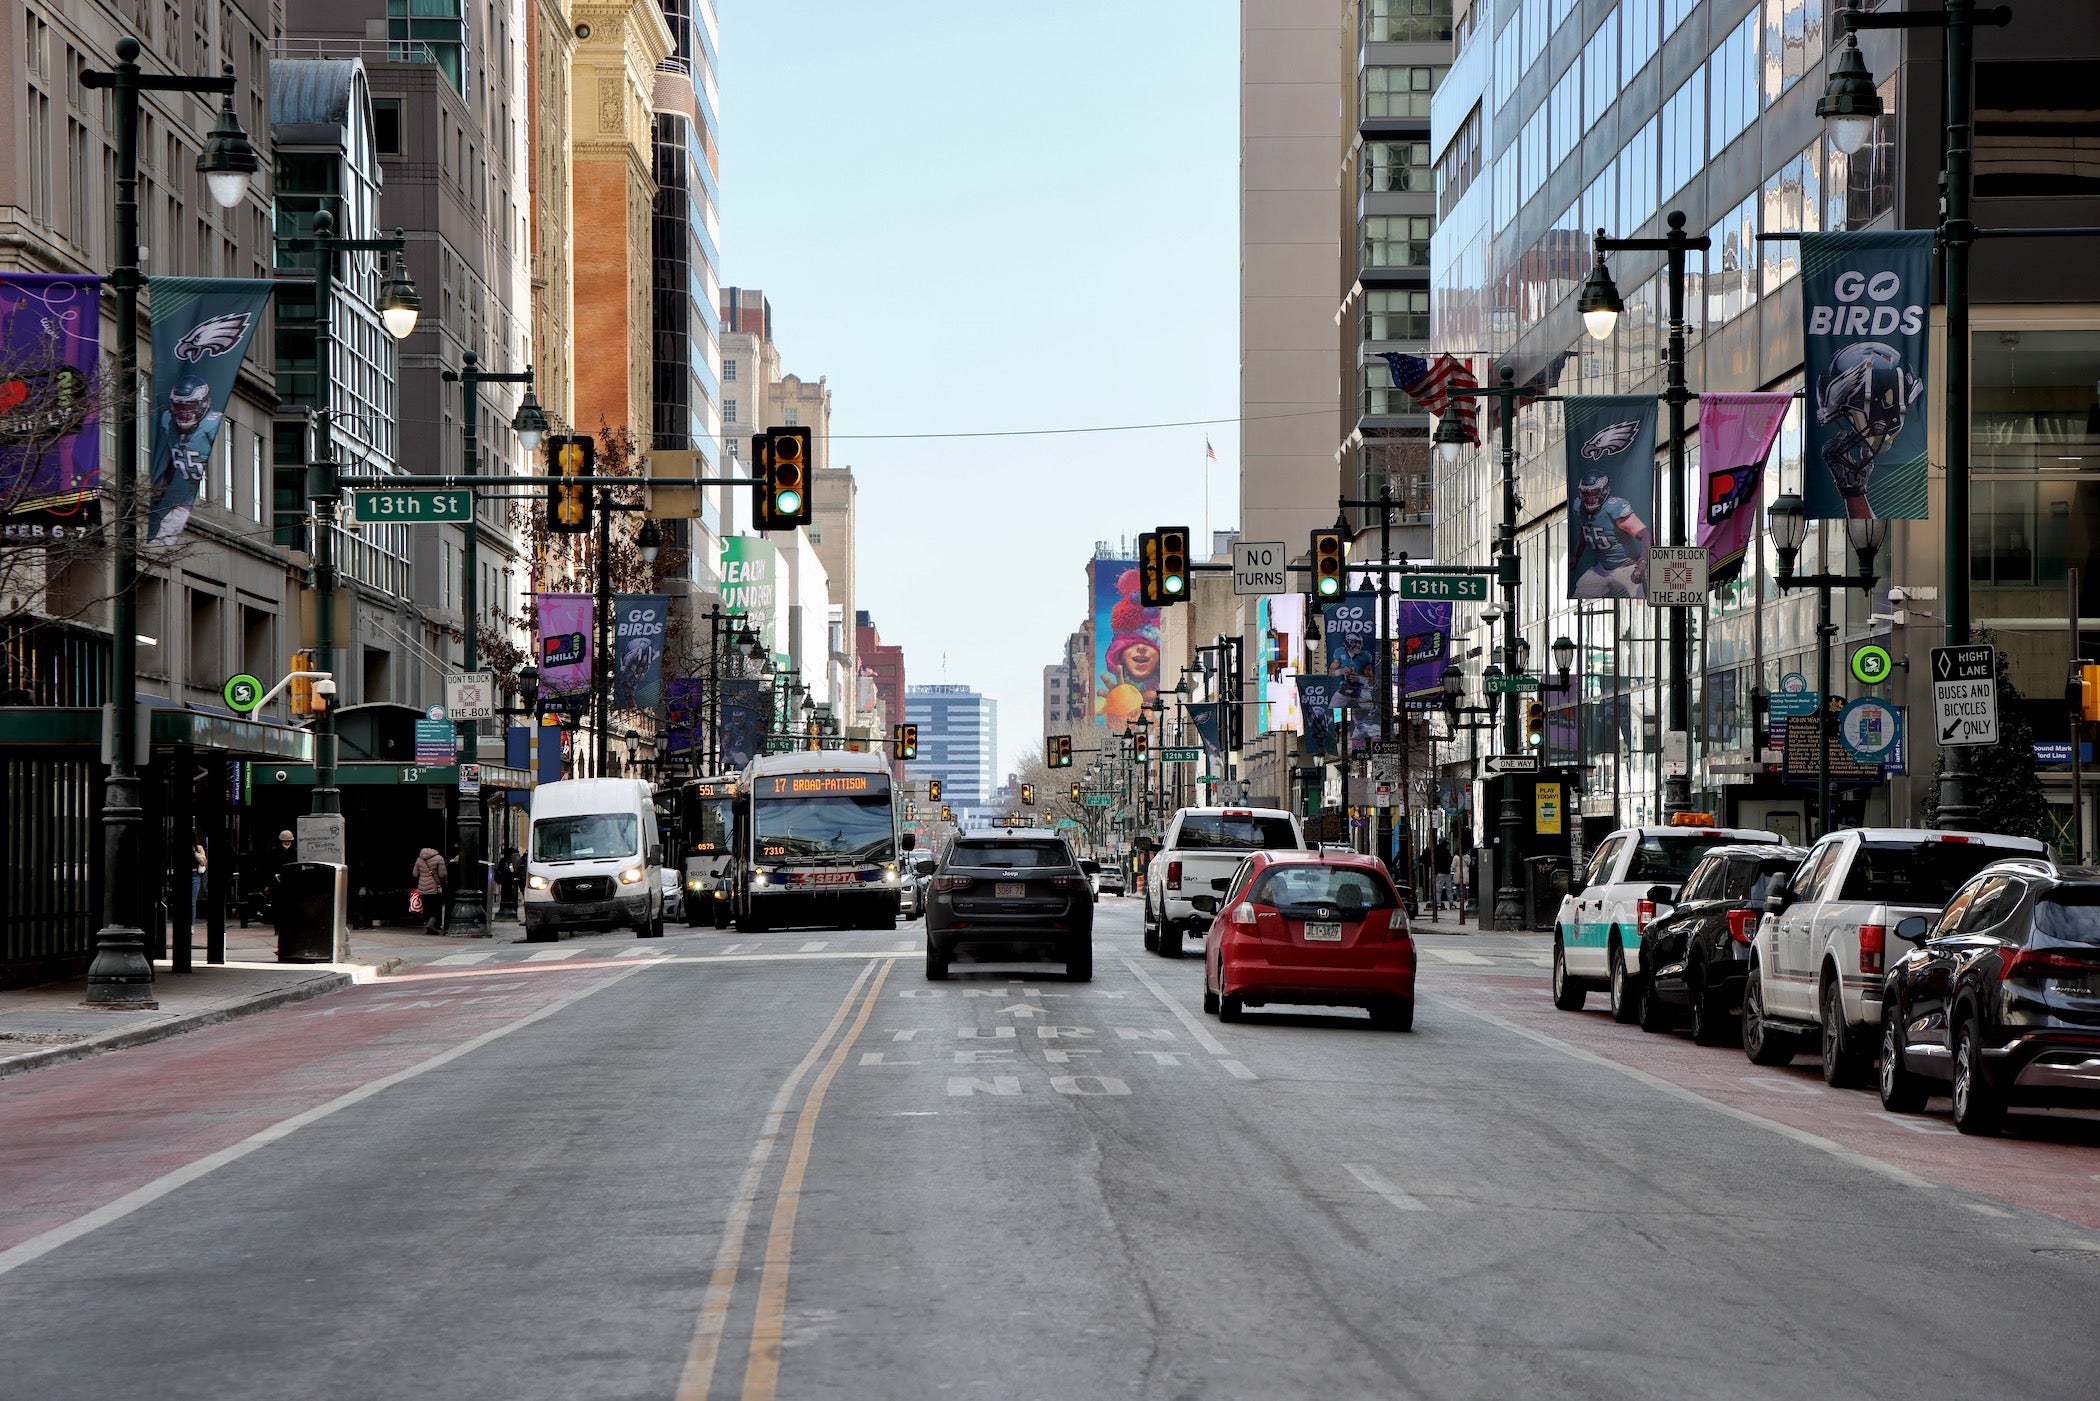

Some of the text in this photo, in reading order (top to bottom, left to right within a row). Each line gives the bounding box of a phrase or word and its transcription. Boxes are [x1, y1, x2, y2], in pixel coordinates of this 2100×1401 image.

[1834, 270, 1900, 302] GO
[1808, 305, 1924, 335] BIRDS
[369, 495, 458, 514] 13th St
[1581, 526, 1612, 550] 65
[1247, 550, 1272, 566] NO
[1677, 550, 1705, 560] BLOCK
[1237, 572, 1283, 585] TURNS
[1411, 580, 1478, 595] 13th St
[1653, 592, 1703, 603] THE BOX
[628, 609, 655, 623] GO
[1336, 606, 1364, 620] GO
[617, 622, 663, 636] BIRDS
[1327, 619, 1373, 634] BIRDS
[545, 651, 580, 664] PHILLY
[1407, 648, 1440, 663] PHILLY
[1958, 650, 1989, 662] RIGHT
[1959, 665, 1988, 677] LANE
[468, 674, 490, 683] BLOCK
[1304, 685, 1325, 696] GO
[1516, 684, 1539, 692] STREET
[1938, 684, 1990, 699] BUSES AND
[449, 707, 490, 717] THE BOX
[1944, 702, 1986, 716] BICYCLES
[1963, 720, 1991, 735] ONLY
[781, 741, 789, 749] St
[699, 784, 714, 796] 551
[774, 777, 866, 793] 17 BROAD-PATTISON
[764, 847, 784, 856] 7310
[816, 873, 857, 883] SEPTA
[900, 988, 1129, 999] ONLY
[884, 1025, 1179, 1042] TURN
[858, 1048, 1191, 1067] LEFT
[948, 1075, 1133, 1097] NO
